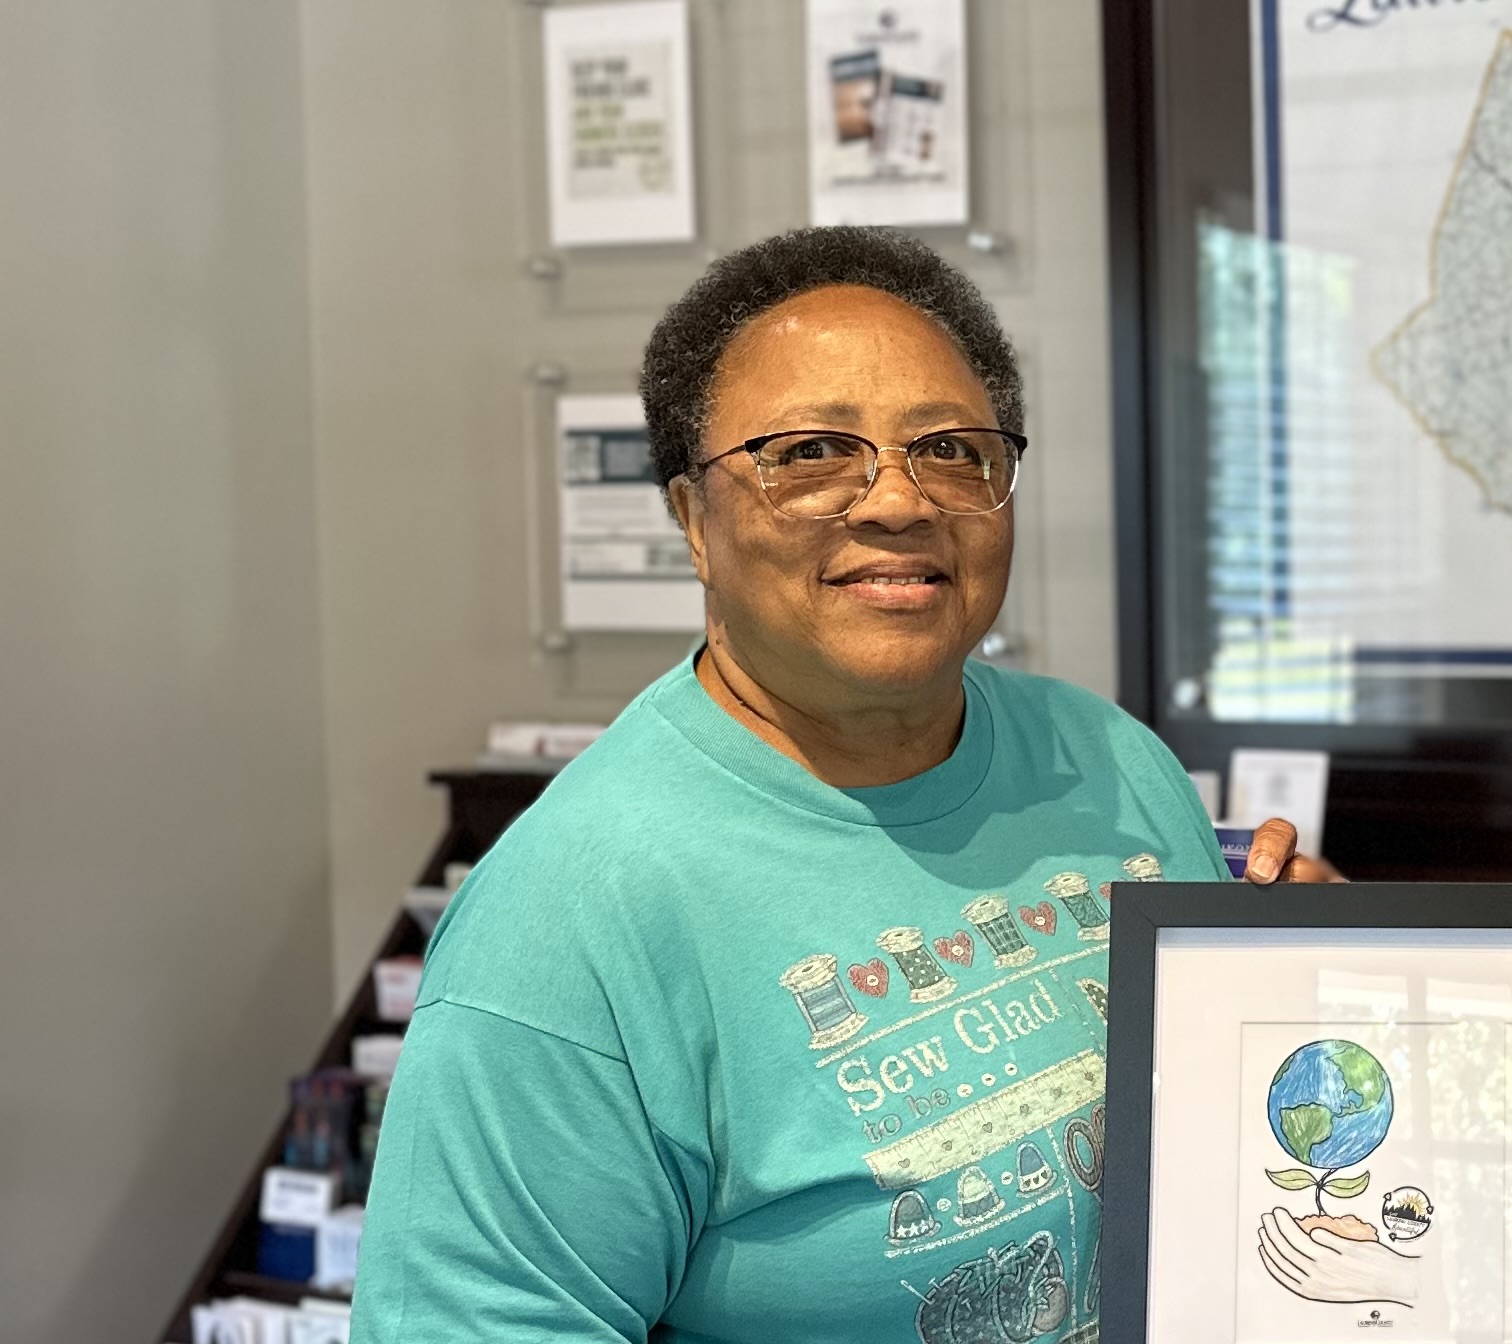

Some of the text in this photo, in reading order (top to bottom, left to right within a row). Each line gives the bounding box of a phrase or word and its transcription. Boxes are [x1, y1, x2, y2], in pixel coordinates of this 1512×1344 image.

[837, 978, 1062, 1116] Sew Glad
[862, 1086, 952, 1143] to be
